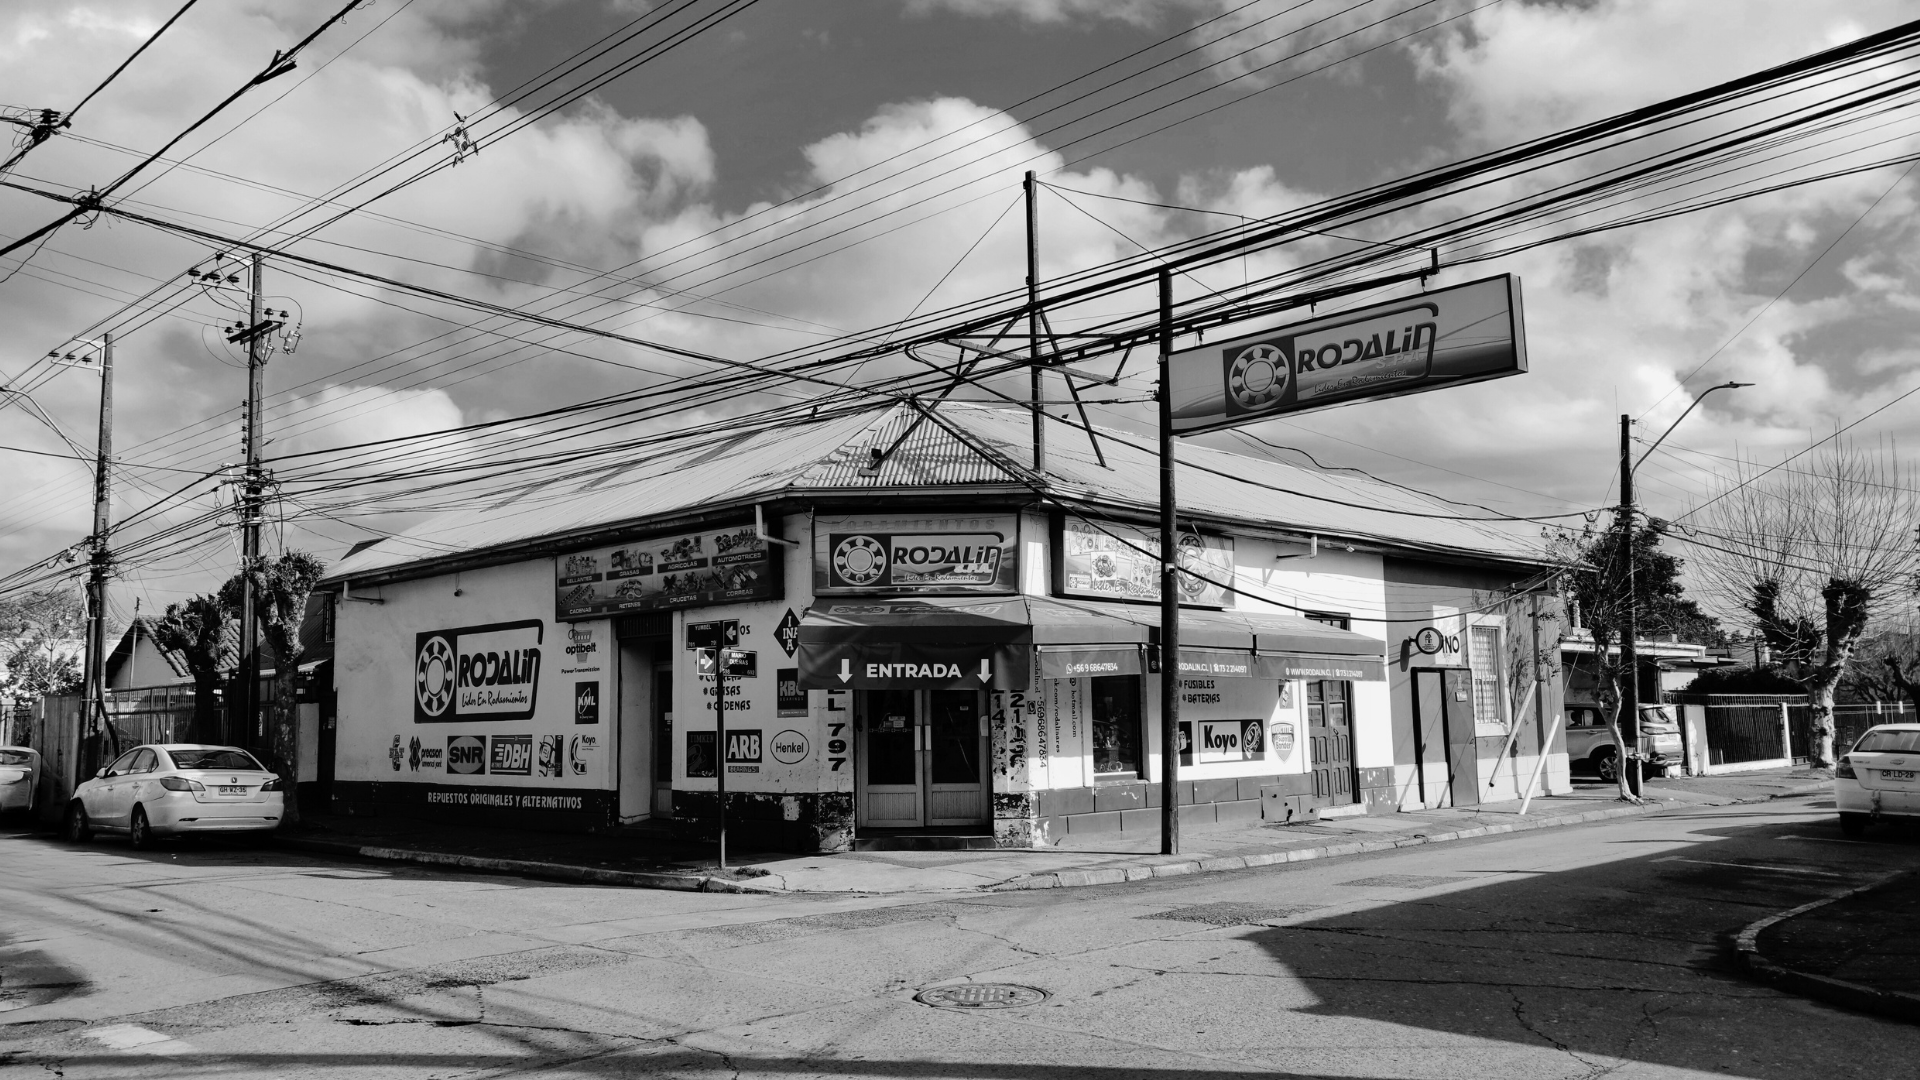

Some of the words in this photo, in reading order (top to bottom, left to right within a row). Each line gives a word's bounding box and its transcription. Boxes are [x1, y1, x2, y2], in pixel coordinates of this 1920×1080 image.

[718, 552, 762, 564] AUTOMOTRICES
[670, 594, 697, 604] CRUCETAS
[566, 642, 597, 655] optibelt
[866, 663, 963, 679] ENTRADA
[1184, 679, 1216, 689] FUSIBLES
[1187, 693, 1221, 704] BATERIAS
[713, 700, 751, 711] CDENAS
[582, 735, 598, 746] Koyo
[1204, 725, 1238, 755] Koyo
[728, 735, 760, 759] ARB
[776, 742, 804, 754] Henkel
[449, 747, 486, 764] SNR
[428, 792, 468, 805] REPUESTOS
[470, 793, 514, 807] ORIGINALES
[515, 795, 521, 807] Y
[522, 796, 583, 810] ALTERNATIVOS
